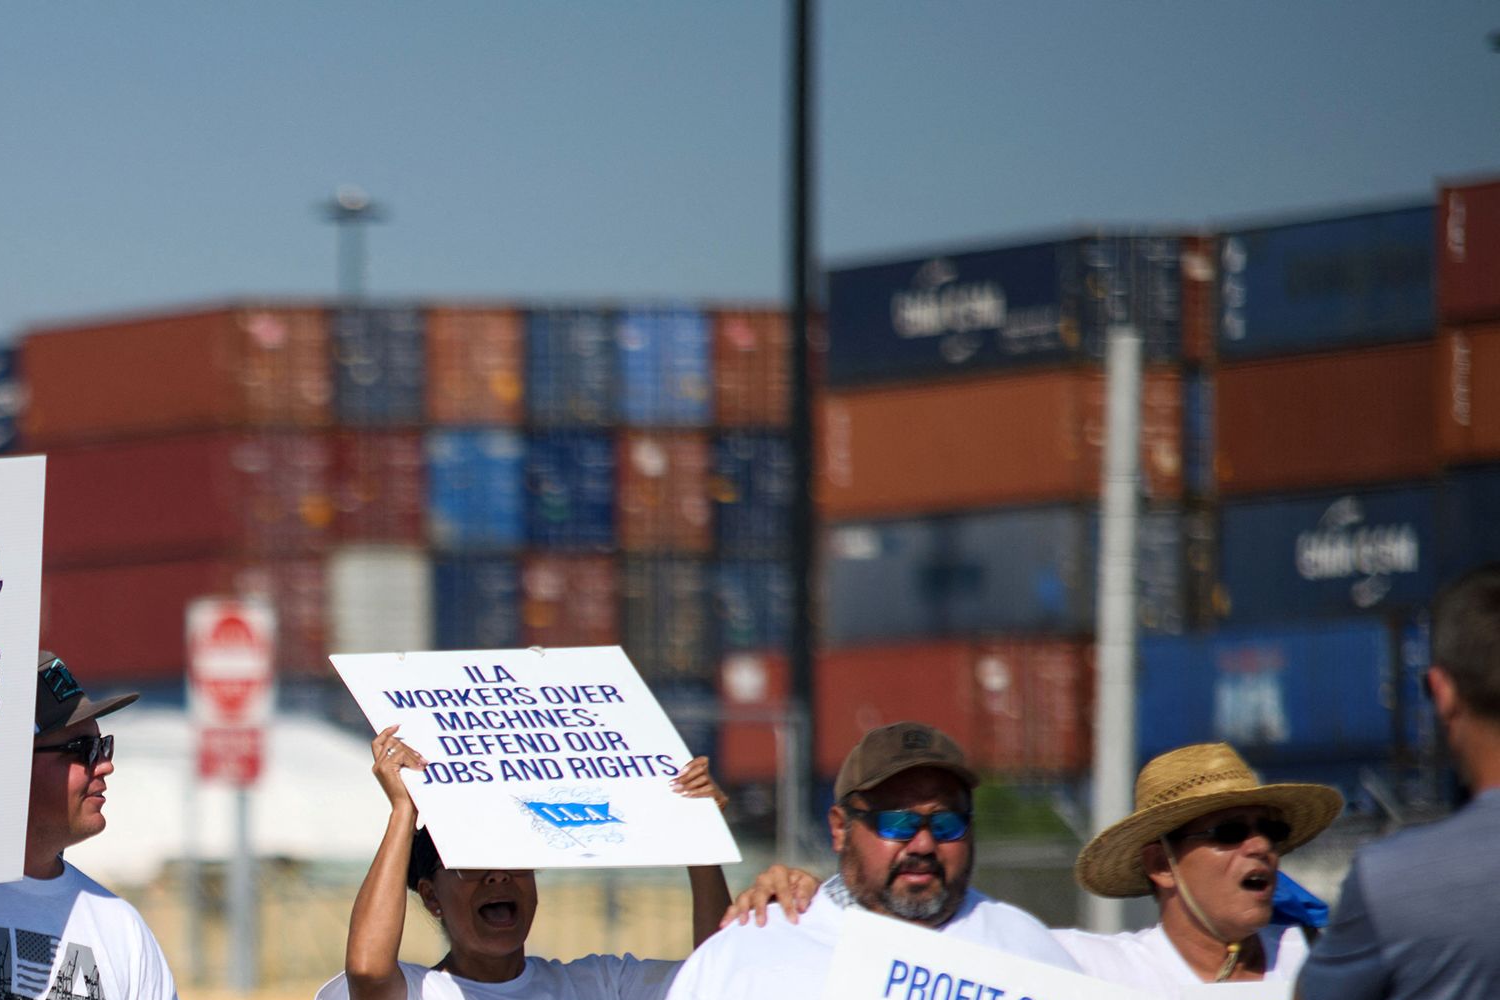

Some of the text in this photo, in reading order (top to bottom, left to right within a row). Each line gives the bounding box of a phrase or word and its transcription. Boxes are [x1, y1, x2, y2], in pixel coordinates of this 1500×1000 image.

[464, 665, 517, 684] ILA
[383, 685, 624, 709] WORKERS OVER
[432, 708, 604, 731] MACHINES:
[438, 731, 630, 756] DEFEND OUR
[423, 754, 679, 784] JOBS AND RIGHTS
